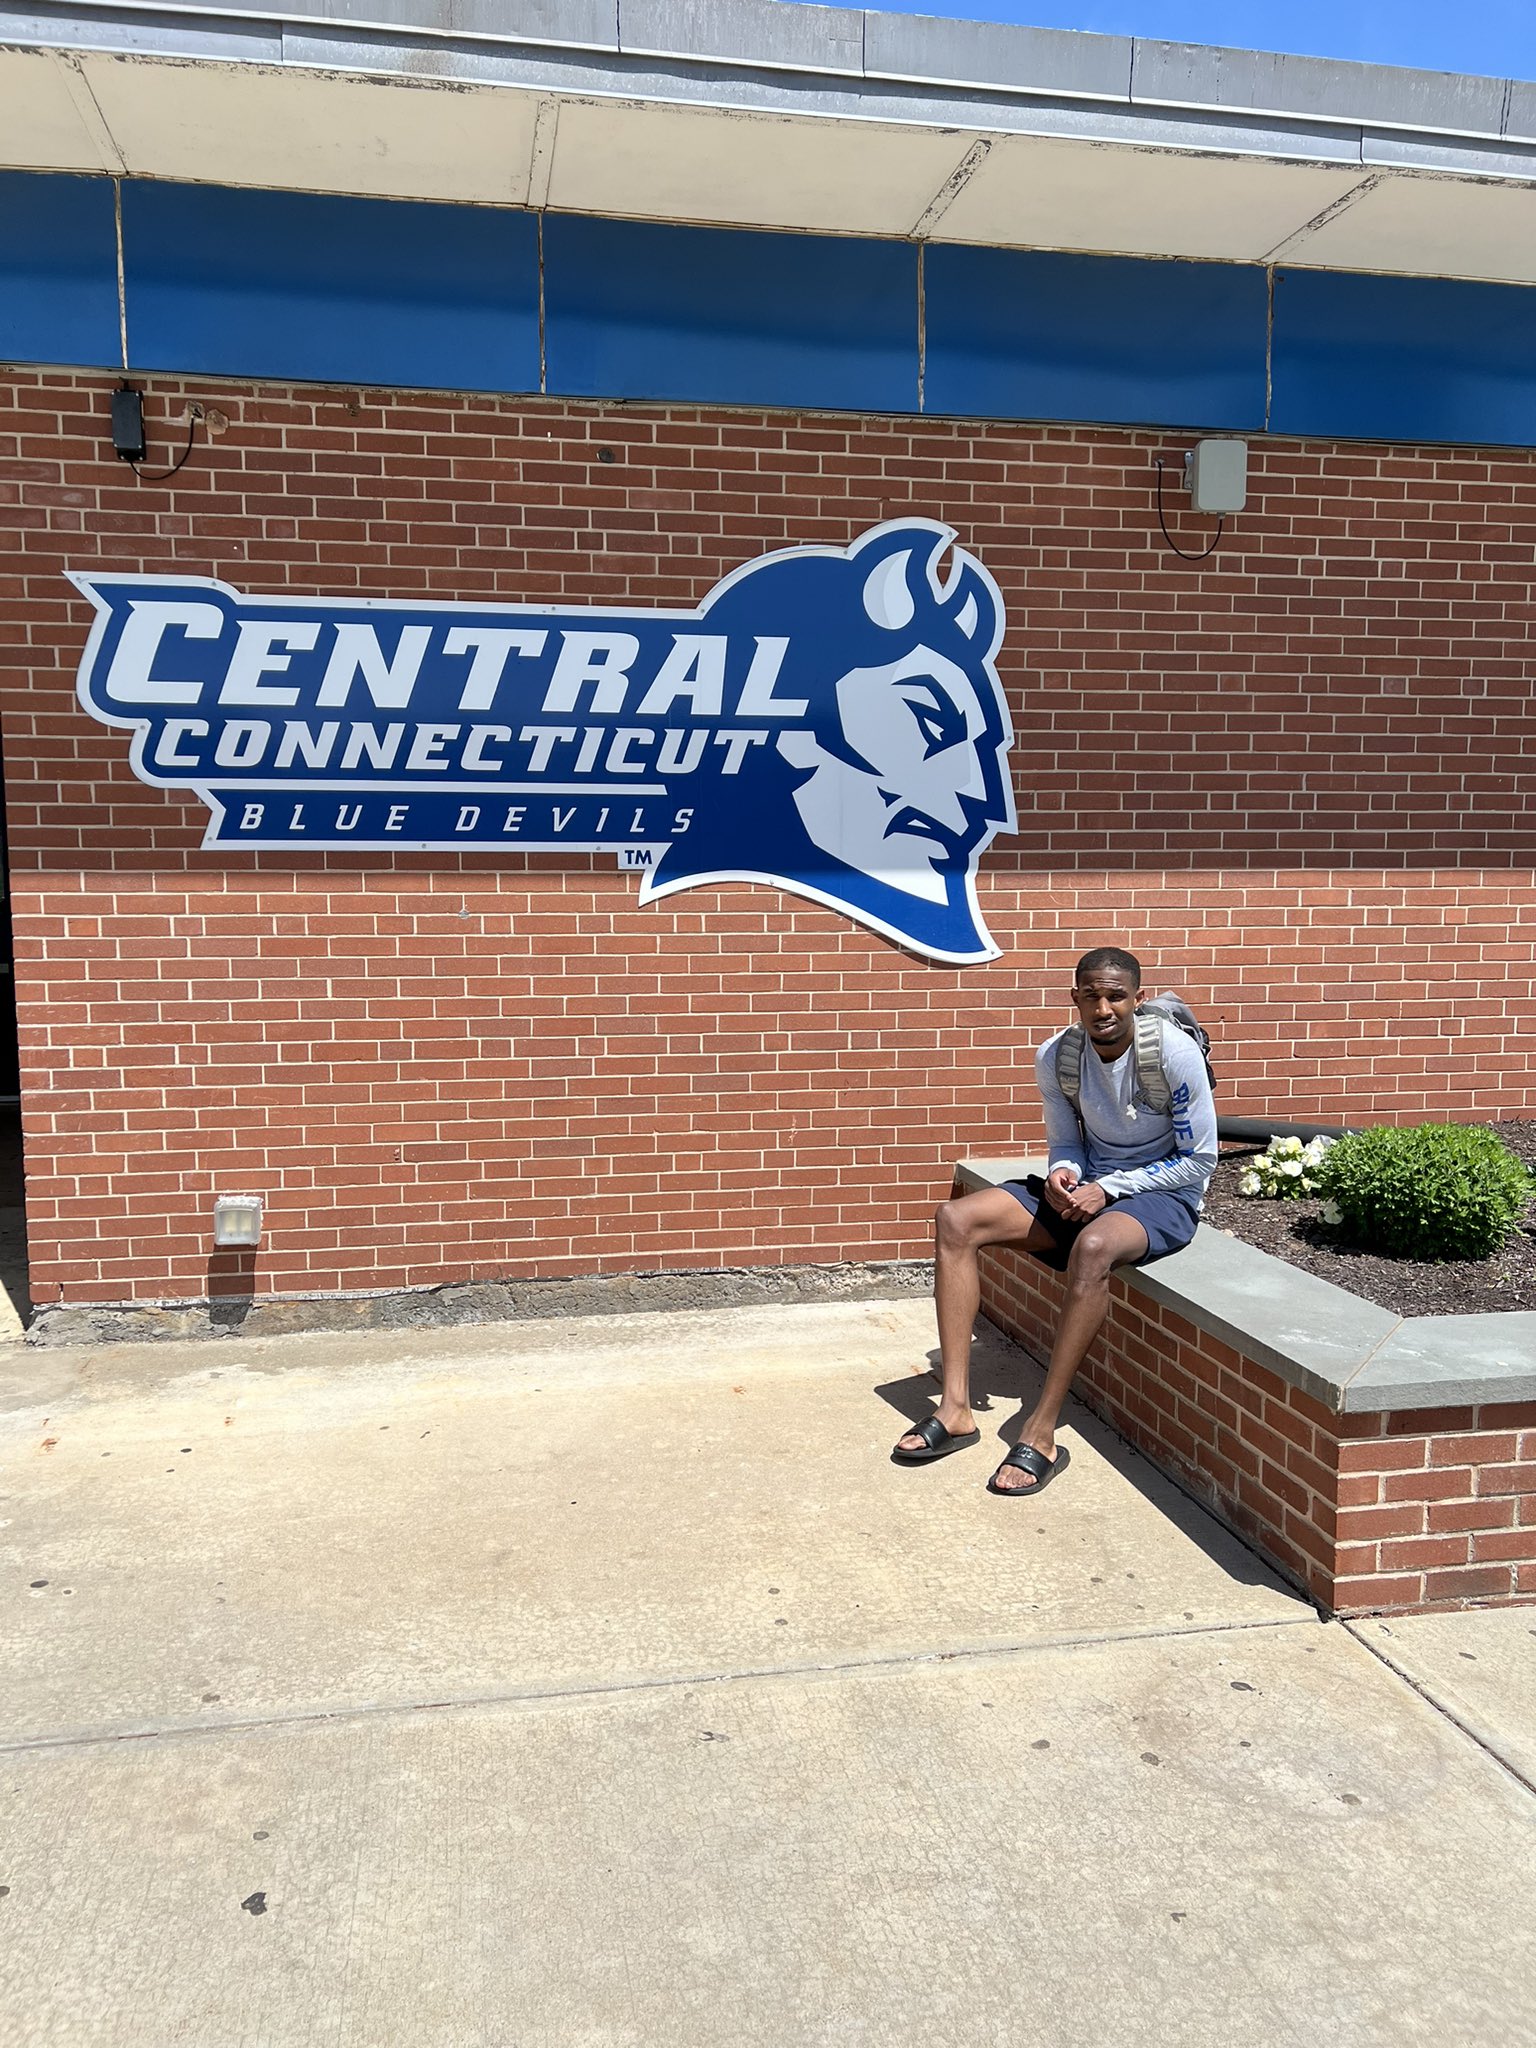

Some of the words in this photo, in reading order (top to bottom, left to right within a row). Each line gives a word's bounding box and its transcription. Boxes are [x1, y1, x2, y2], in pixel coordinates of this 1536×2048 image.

[105, 600, 810, 717] CENTRAL
[154, 718, 770, 775] CONNECTICUT
[239, 803, 410, 831] BLUE
[455, 806, 694, 833] DEVILS
[625, 849, 653, 865] TM
